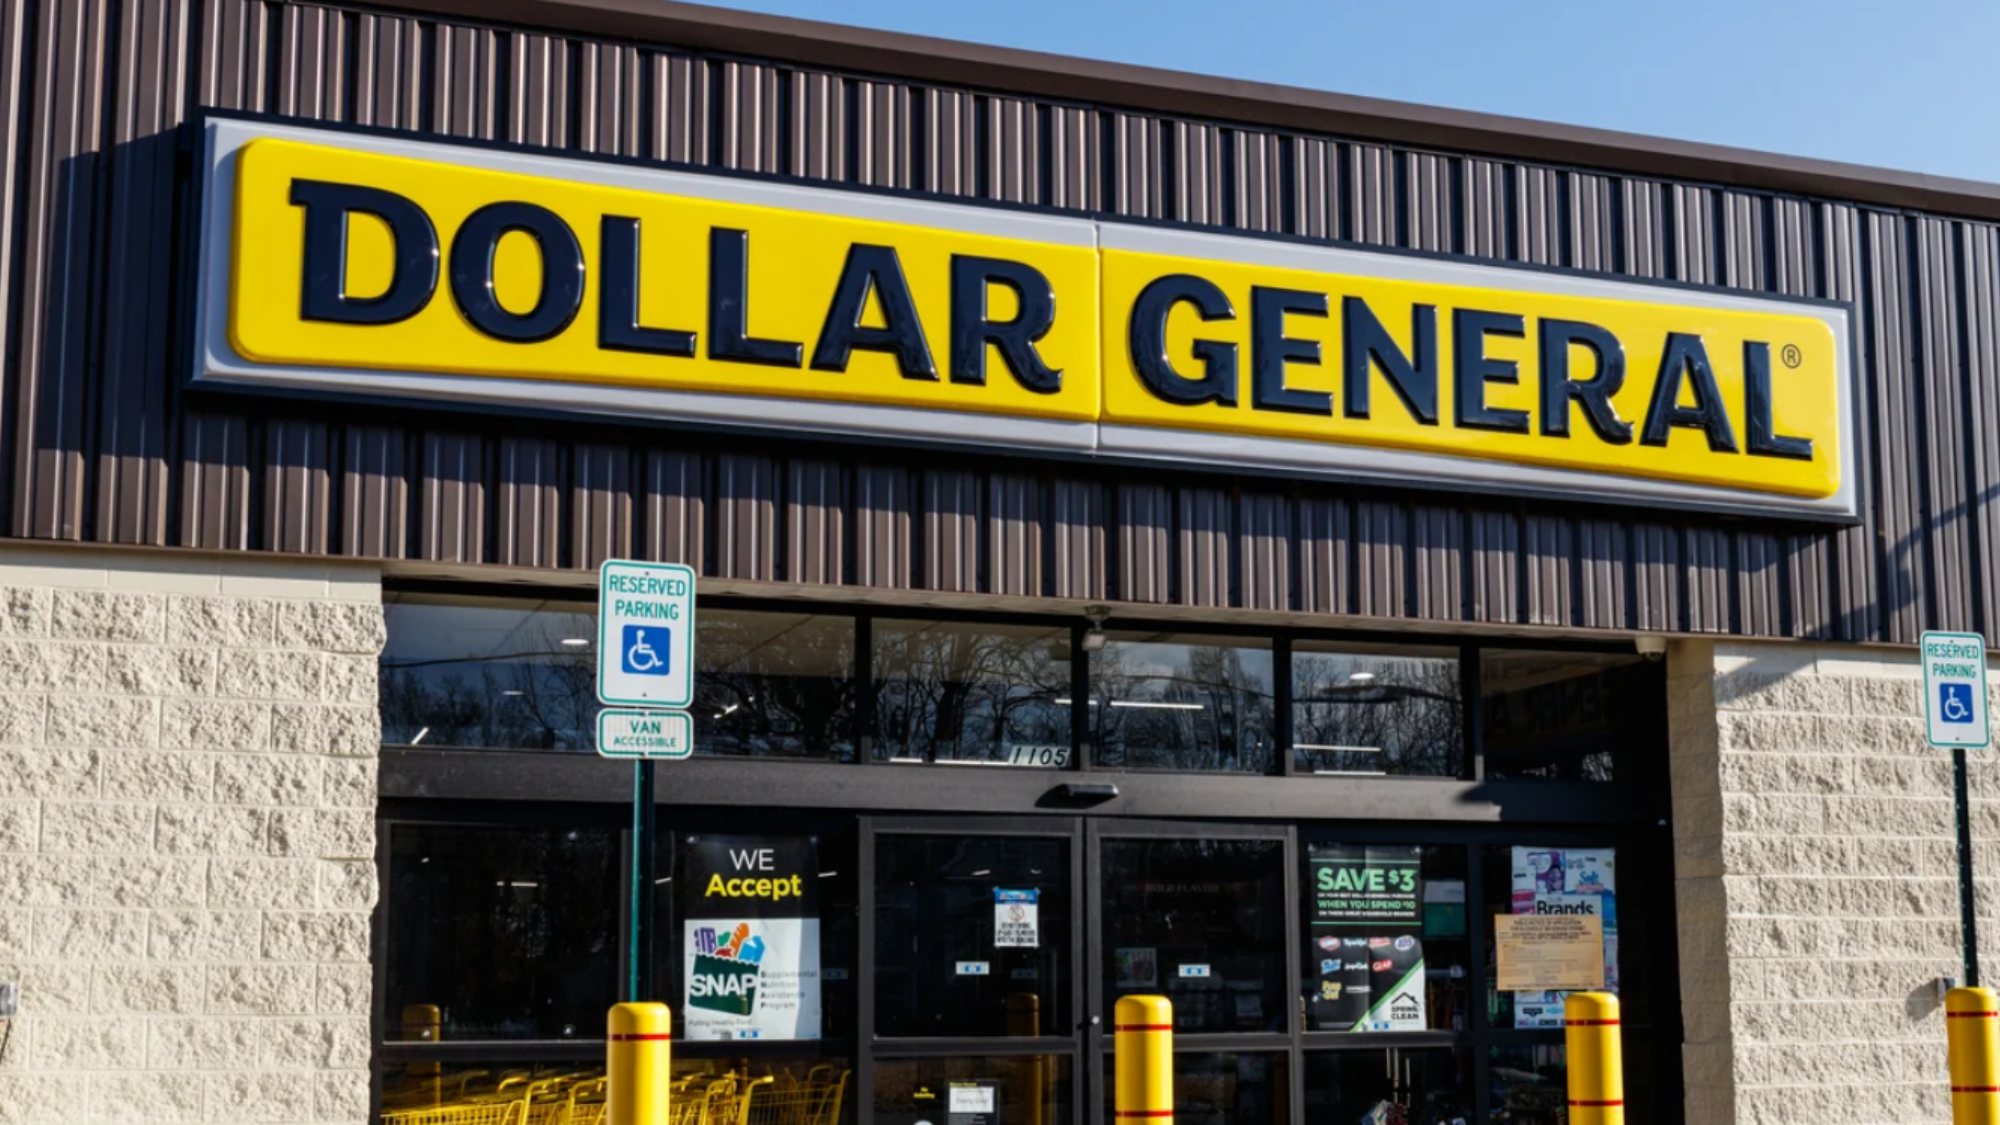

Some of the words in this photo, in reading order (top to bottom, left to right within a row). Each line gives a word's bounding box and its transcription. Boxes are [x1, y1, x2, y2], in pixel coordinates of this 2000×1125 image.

[288, 177, 1064, 395] DOLLAR
[608, 574, 687, 597] RESERVED
[614, 599, 680, 621] PARKING
[1926, 642, 1980, 659] RESERVED
[1932, 662, 1977, 678] PARKING
[630, 720, 661, 734] VAN
[613, 736, 677, 748] ACCESSIBLE
[1013, 746, 1068, 765] 1105
[729, 849, 775, 871] WE
[704, 873, 802, 901] Accept
[1317, 867, 1385, 891] SAVE
[1317, 900, 1348, 909] WHEN
[1349, 900, 1369, 909] YOU
[1371, 900, 1401, 909] SPEND
[1537, 900, 1594, 915] Brands
[760, 970, 817, 979] Supplemental
[690, 973, 758, 997] SNAP
[760, 1001, 796, 1010] Program
